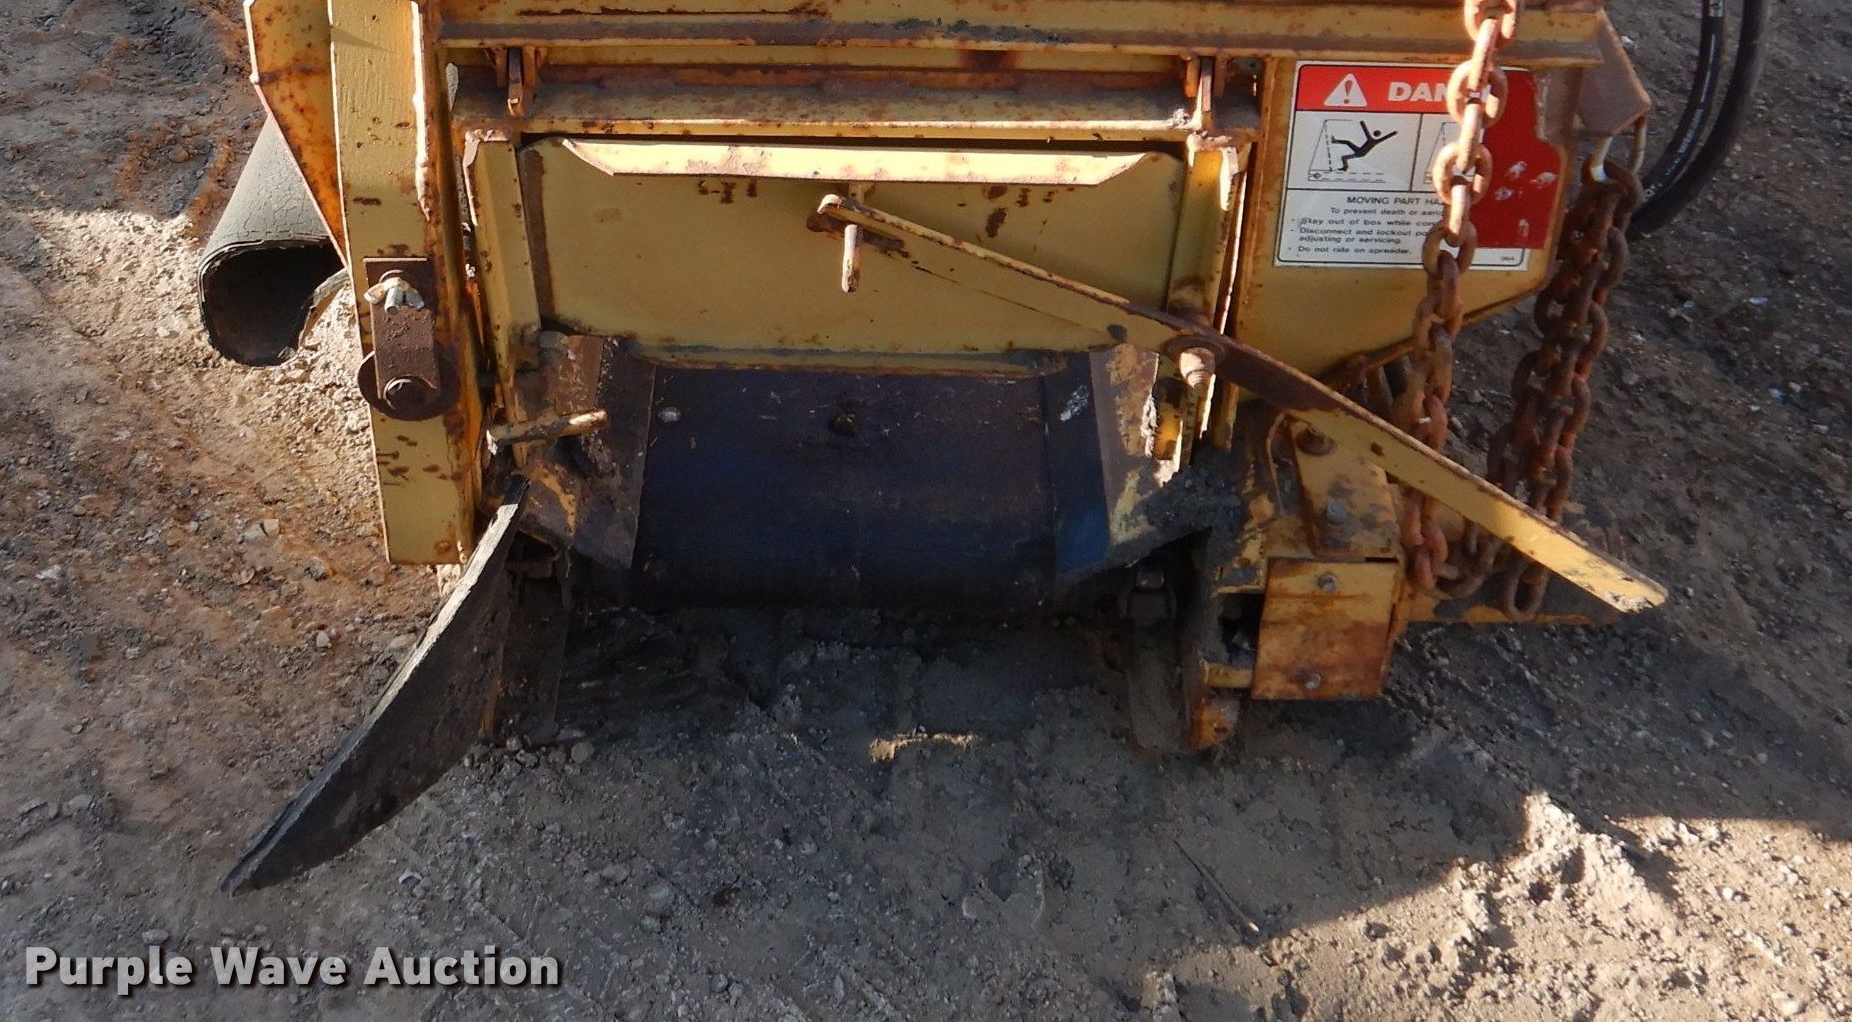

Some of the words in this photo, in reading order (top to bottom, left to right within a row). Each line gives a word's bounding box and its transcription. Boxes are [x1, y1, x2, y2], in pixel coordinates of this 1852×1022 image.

[1347, 196, 1389, 205] MOVING
[1393, 197, 1420, 205] PART
[1301, 217, 1324, 226] Stay
[1299, 227, 1352, 235] Disconnect
[1298, 235, 1342, 244] adjusting
